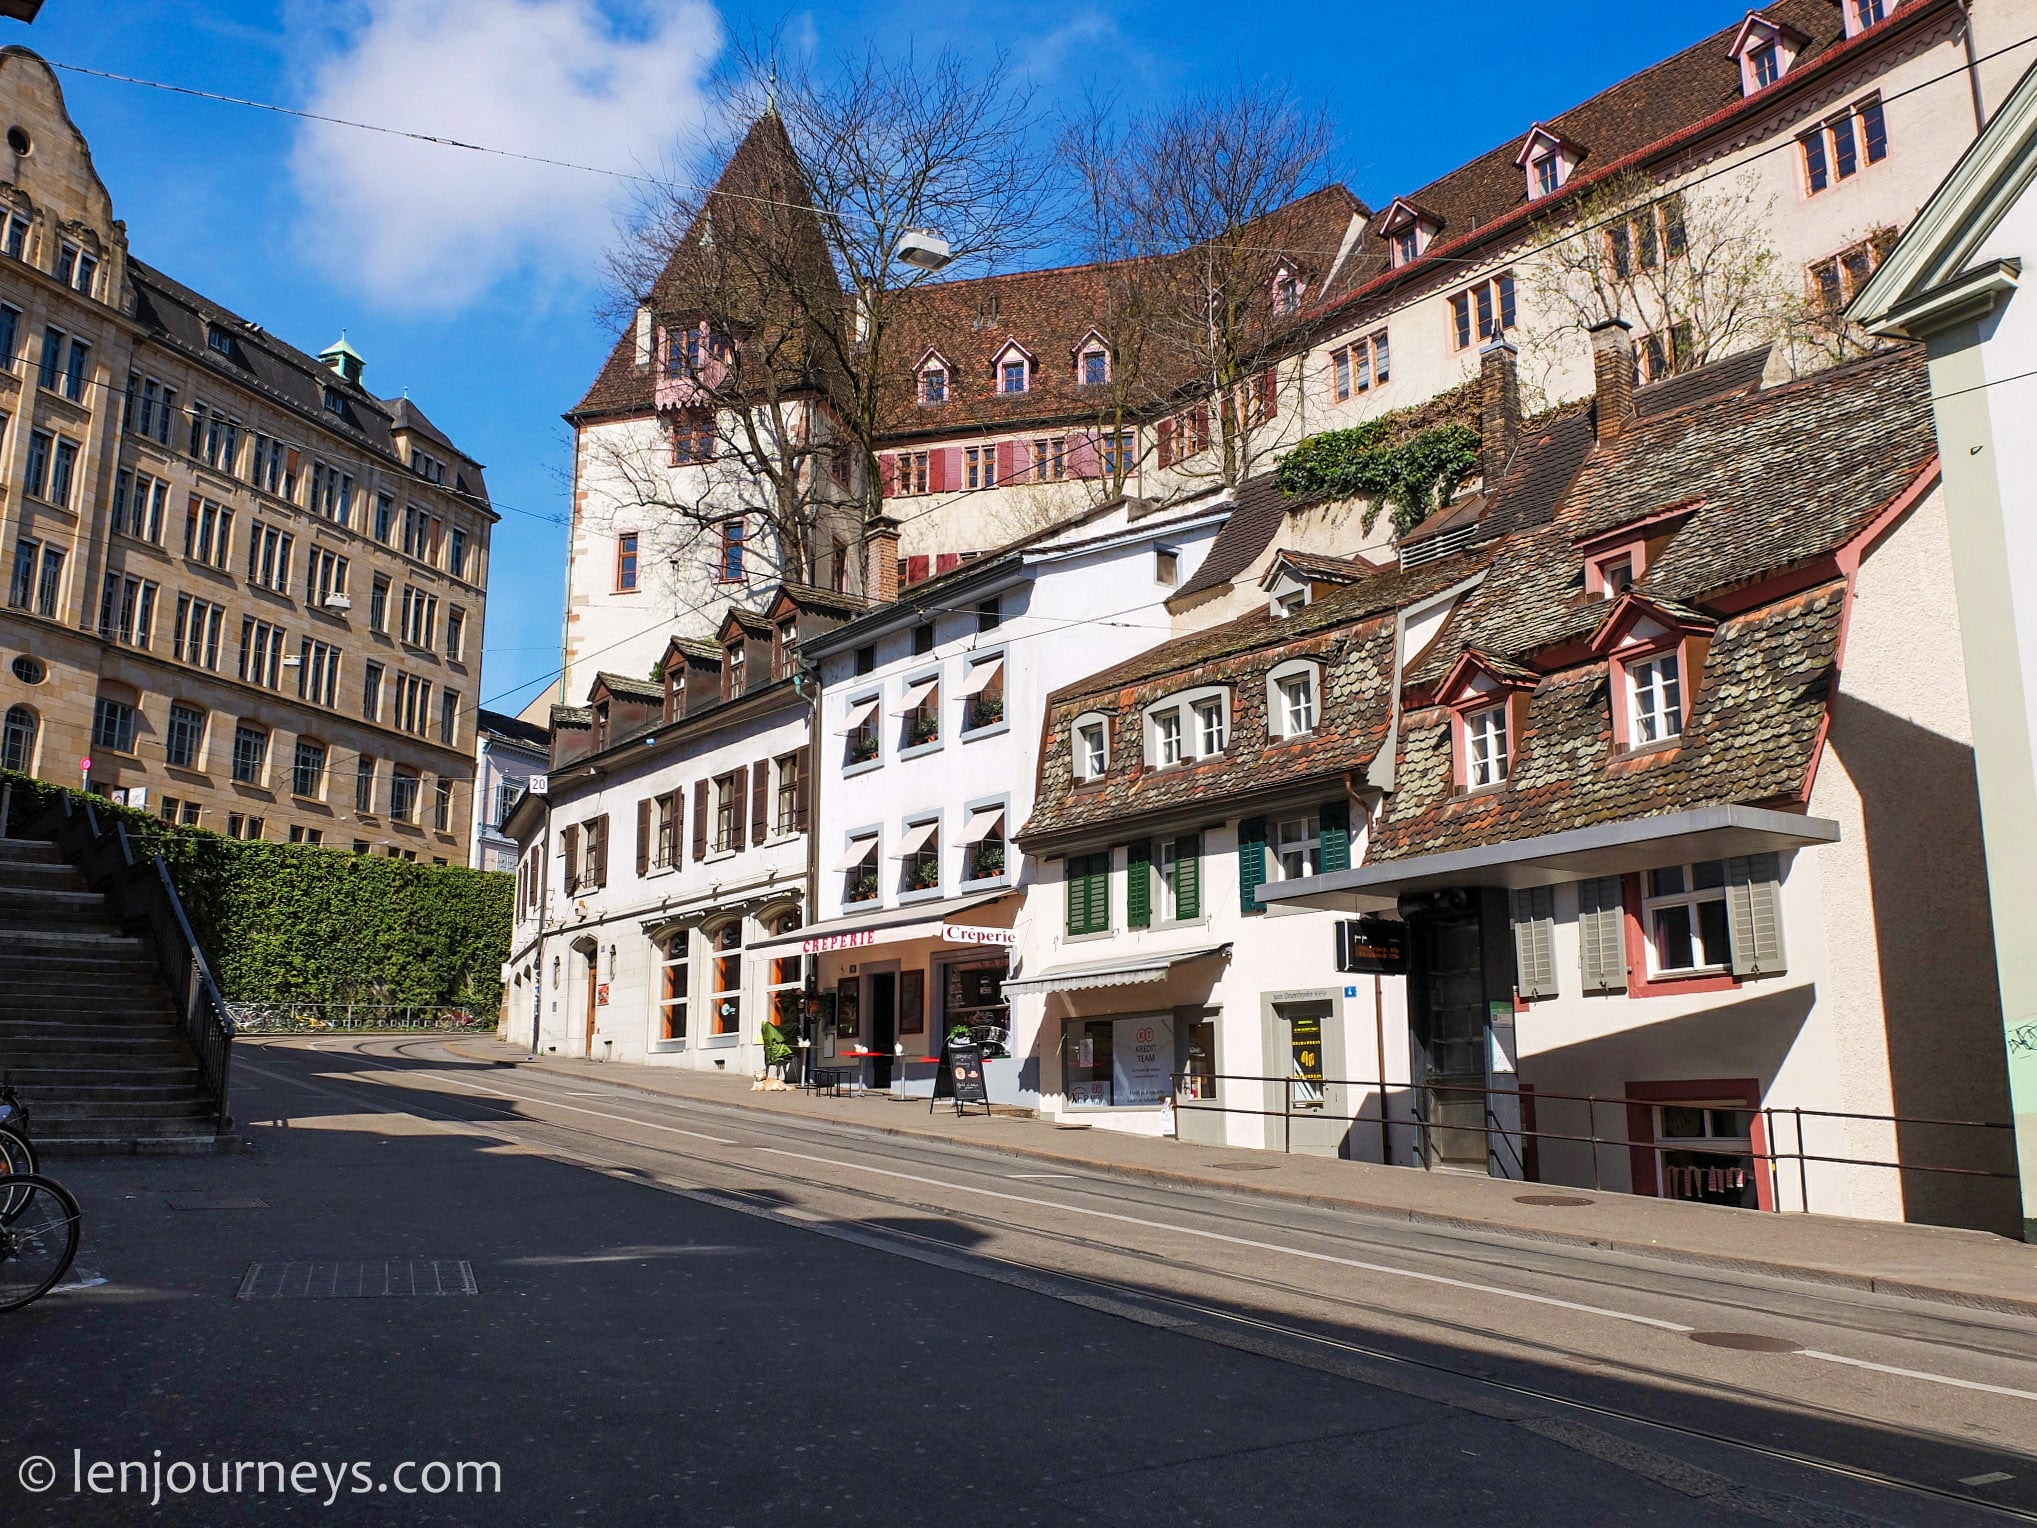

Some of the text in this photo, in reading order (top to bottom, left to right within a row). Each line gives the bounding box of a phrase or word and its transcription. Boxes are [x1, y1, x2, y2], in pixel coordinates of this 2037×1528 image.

[532, 778, 546, 790] 20
[946, 926, 1016, 944] Crêperie
[802, 930, 876, 954] CREPERIE
[1135, 1044, 1156, 1053] KREDIT
[1137, 1054, 1155, 1063] TEAM
